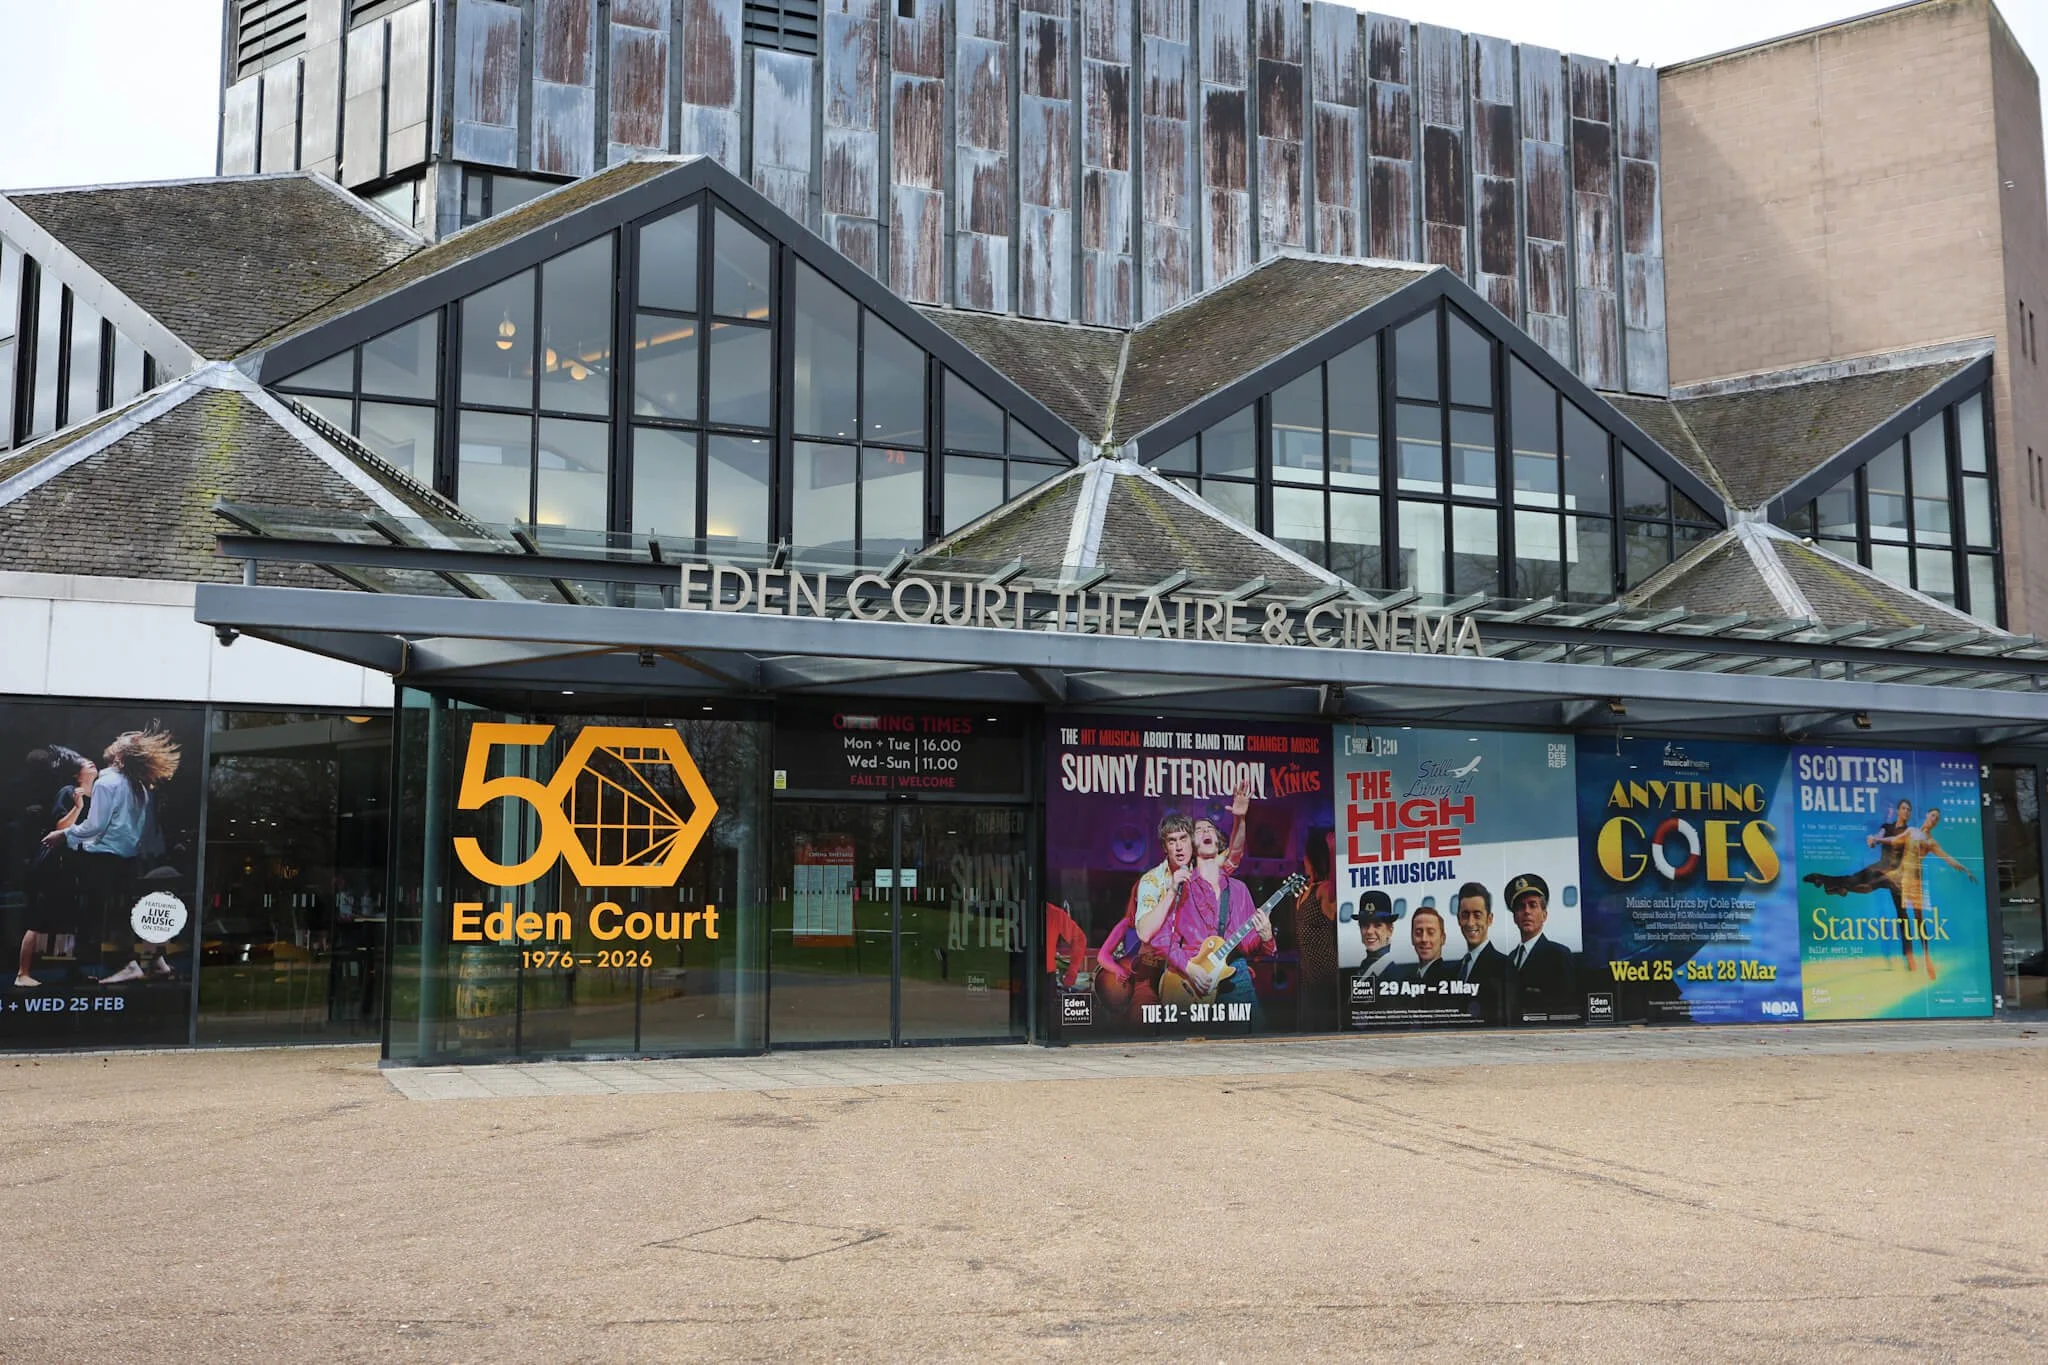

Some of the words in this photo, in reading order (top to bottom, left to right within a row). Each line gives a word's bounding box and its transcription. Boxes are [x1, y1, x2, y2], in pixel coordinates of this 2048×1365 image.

[680, 563, 827, 616] EDEN
[847, 574, 1033, 629] COURT
[1051, 590, 1248, 641] THEATRE
[1261, 602, 1295, 645] &
[1305, 604, 1485, 656] CINEMA
[922, 717, 973, 734] TIMES
[844, 736, 872, 749] Mon
[888, 737, 911, 750] Tue
[922, 739, 961, 752] 16.00
[1060, 728, 1078, 745] THE
[1081, 729, 1096, 746] HIT
[1099, 730, 1140, 747] MUSICAL
[1143, 731, 1173, 748] ABOUT
[1176, 733, 1192, 749] THE
[1195, 734, 1220, 750] BAND
[1222, 735, 1245, 751] THAT
[1247, 735, 1288, 752] CHANGED
[1291, 737, 1319, 754] MUSIC
[1383, 739, 1397, 755] 20
[1548, 744, 1567, 752] DUN
[922, 757, 958, 770] 11.00
[1548, 752, 1567, 760] DEE
[1548, 760, 1567, 768] REP
[1061, 753, 1138, 794] SUNNY
[1144, 757, 1267, 800] AFTERNOON
[1418, 759, 1453, 778] Still
[1800, 754, 1904, 784] SCOTTISH
[898, 776, 956, 788] WELCOME
[1346, 770, 1392, 801] THE
[1403, 779, 1449, 800] Living
[1456, 776, 1474, 794] it!
[1607, 779, 1765, 813] ANYTHING
[1801, 785, 1878, 813] BALLET
[1347, 795, 1475, 833] HIGH
[1347, 828, 1461, 865] LIFE
[1597, 816, 1780, 884] GOES
[1348, 867, 1380, 888] THE
[1383, 860, 1456, 885] MUSICAL
[145, 901, 177, 910] FEATURING
[1626, 897, 1651, 908] Music
[1653, 897, 1669, 908] and
[1671, 897, 1696, 911] Lyrics
[1697, 897, 1709, 911] by
[1710, 898, 1730, 908] Cole
[1731, 898, 1756, 909] Porter
[141, 915, 175, 927] MUSIC
[149, 908, 170, 918] LIVE
[452, 902, 572, 941] Eden
[589, 902, 719, 941] Court
[1812, 907, 1950, 942] Starstruck
[522, 950, 573, 969] 1976
[597, 949, 653, 968] 2026
[1609, 961, 1649, 981] Wed
[1653, 960, 1673, 981] 25
[1687, 960, 1713, 980] Sat
[1717, 960, 1736, 980] 28
[1740, 960, 1777, 980] Mar
[1353, 980, 1370, 988] Eden
[1353, 987, 1373, 995] Court
[1380, 981, 1399, 995] 29
[1400, 981, 1426, 997] Apr
[1438, 980, 1448, 994] 2
[1450, 980, 1480, 996] May
[25, 998, 65, 1012] WED
[69, 998, 89, 1011] 25
[95, 997, 125, 1010] FEB
[1064, 998, 1085, 1007] Eden
[1590, 997, 1608, 1005] Eden
[1762, 1001, 1799, 1015] NODA
[1064, 1007, 1089, 1016] Court
[1142, 1005, 1162, 1023] TUE
[1164, 1004, 1177, 1023] 12
[1190, 1003, 1210, 1022] SAT
[1212, 1003, 1225, 1022] 16
[1229, 1003, 1251, 1021] MAY
[1590, 1006, 1611, 1014] Court
